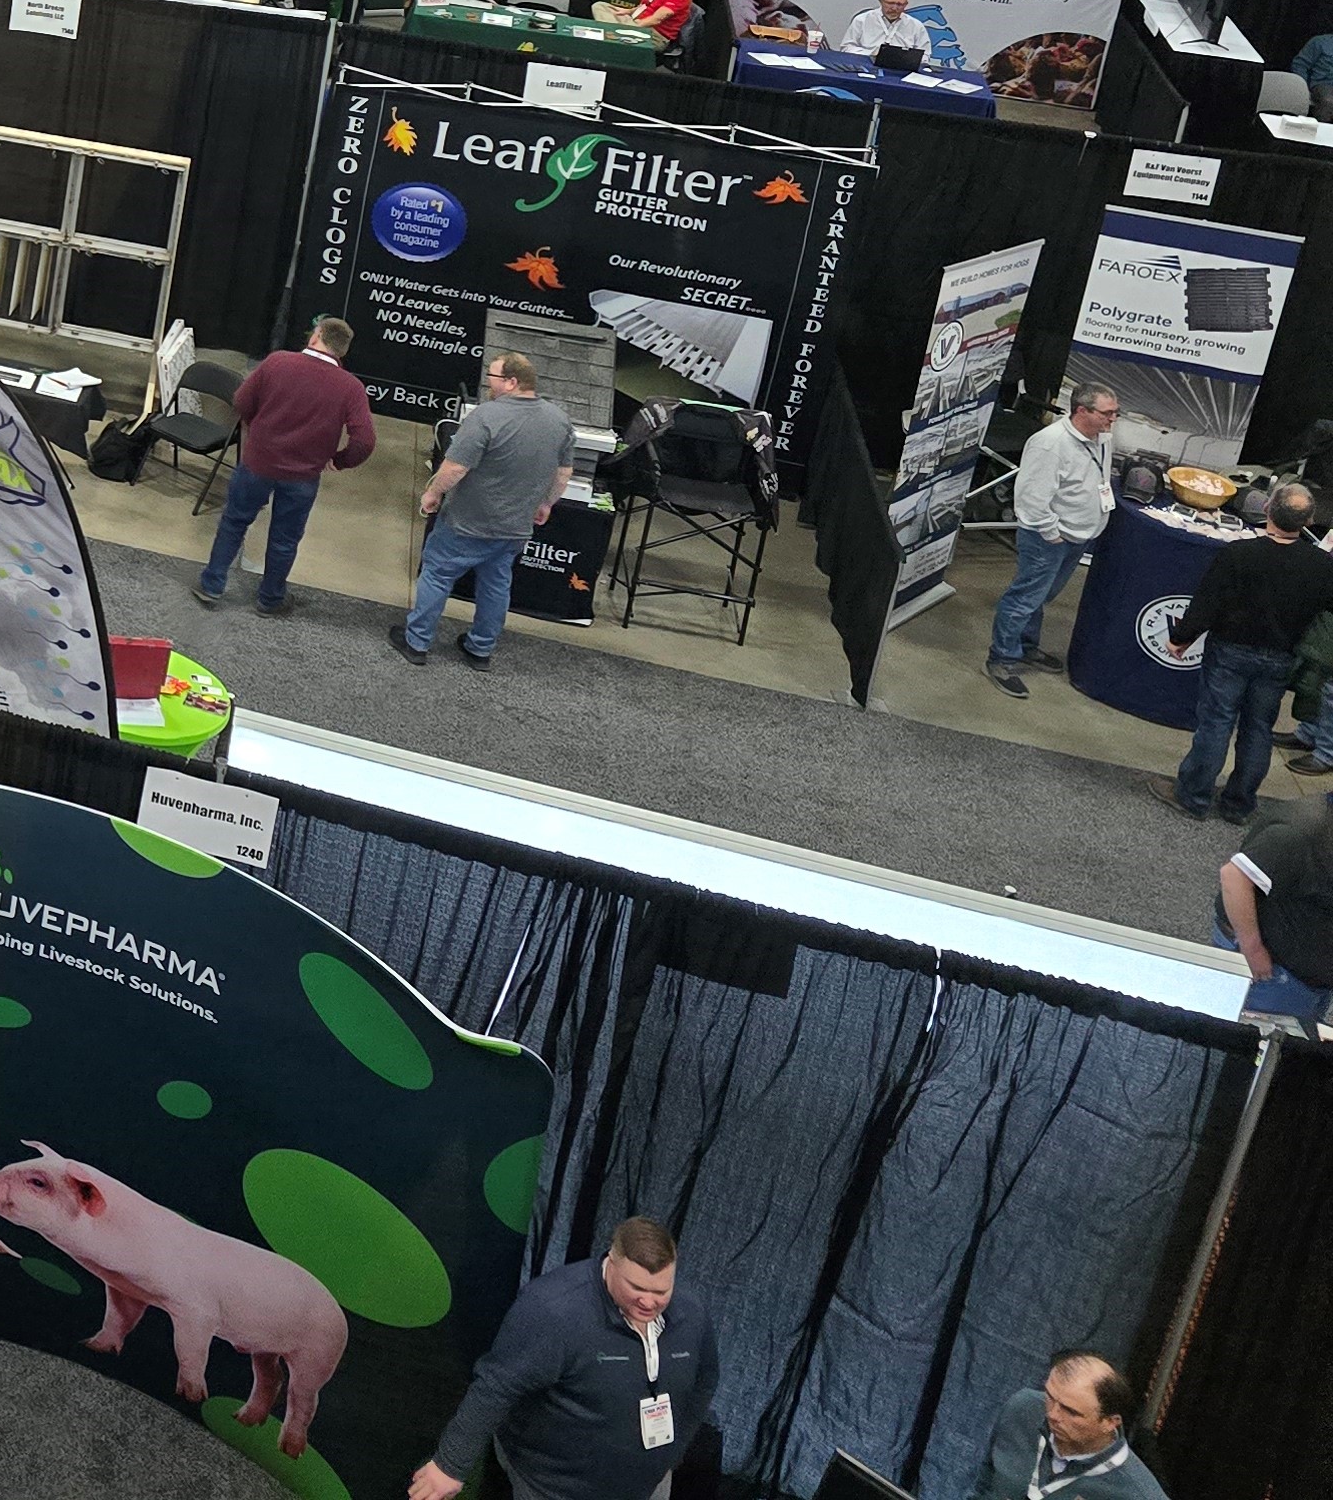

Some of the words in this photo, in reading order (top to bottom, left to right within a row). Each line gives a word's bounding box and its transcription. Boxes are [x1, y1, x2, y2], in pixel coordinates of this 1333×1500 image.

[433, 120, 555, 174] Leaf
[602, 148, 743, 207] Filter
[1145, 162, 1159, 171] R&F
[1161, 164, 1175, 173] Van
[1177, 166, 1202, 175] Voorst
[1133, 170, 1171, 183] Equipment
[1173, 175, 1210, 187] Company
[400, 196, 429, 210] Rated
[431, 199, 444, 213] #1
[598, 187, 668, 211] GUTTER
[391, 207, 403, 218] by
[415, 211, 450, 227] leading
[394, 219, 442, 236] consumer
[595, 201, 707, 232] PROTECTION
[393, 231, 440, 249] magazine
[609, 254, 637, 271] Our
[640, 259, 742, 288] Revolutionary
[1098, 260, 1180, 284] FAROEX
[1090, 302, 1172, 327] Polygrate
[151, 790, 236, 825] Huvepharma,
[240, 812, 265, 832] Inc.
[235, 843, 264, 861] 1240
[39, 943, 125, 985] Livestock
[128, 976, 219, 1024] Solutions.
